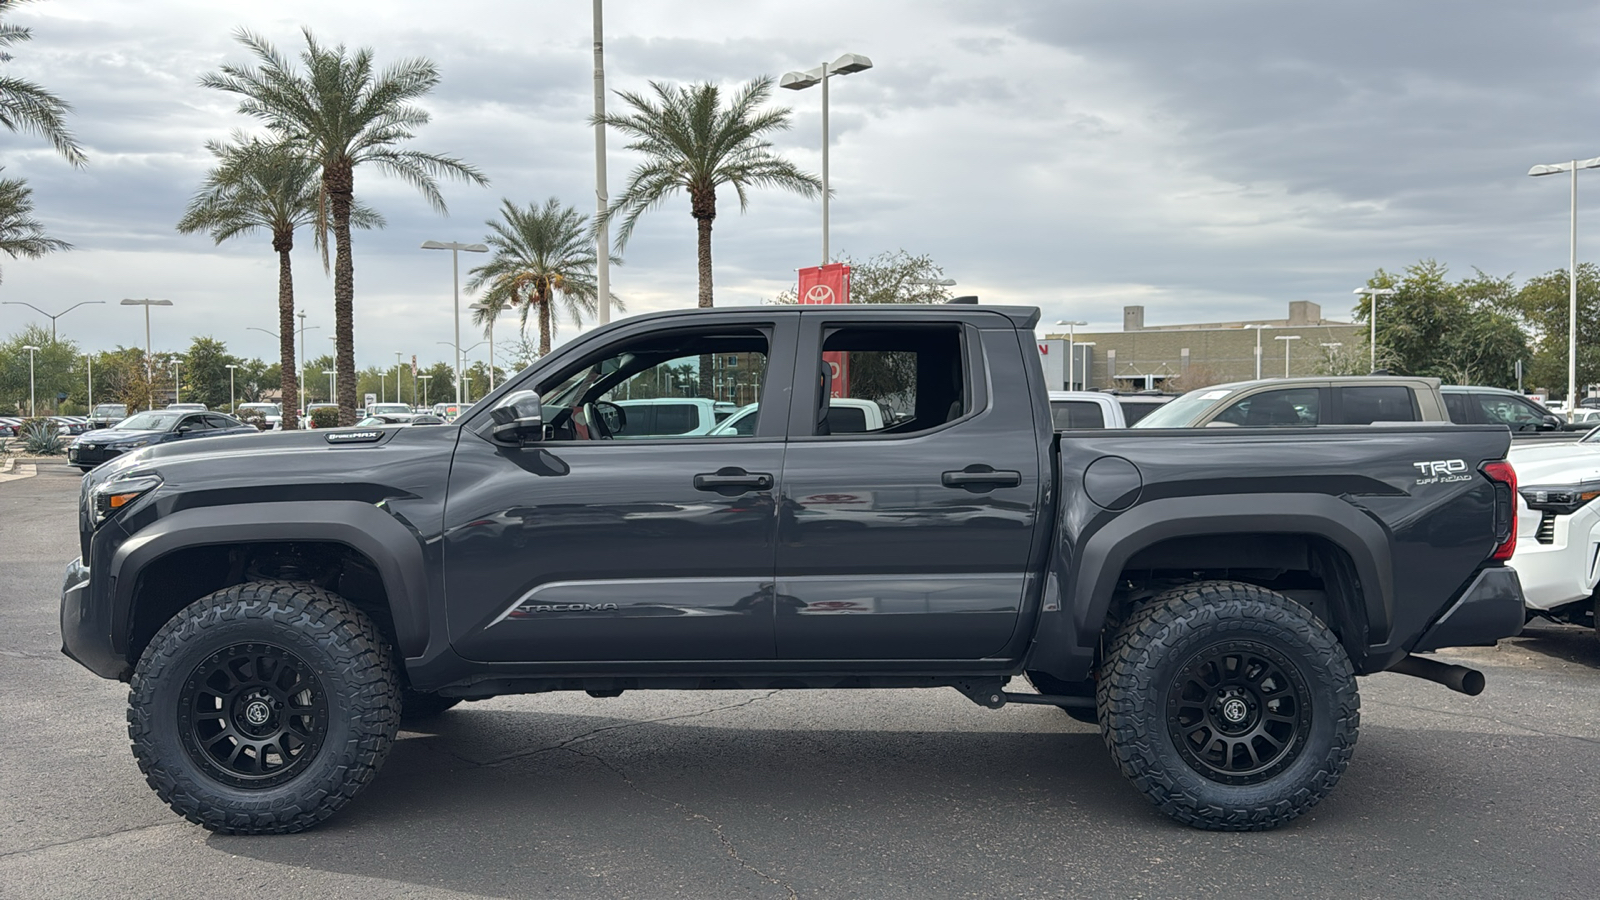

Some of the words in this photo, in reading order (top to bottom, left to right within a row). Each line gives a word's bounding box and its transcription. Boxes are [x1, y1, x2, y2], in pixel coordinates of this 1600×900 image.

[1413, 459, 1468, 476] TRD
[1440, 475, 1472, 483] ROAD
[520, 602, 619, 613] TACOMA
[272, 624, 323, 658] TOYO
[1216, 620, 1305, 648] COUNTRY
